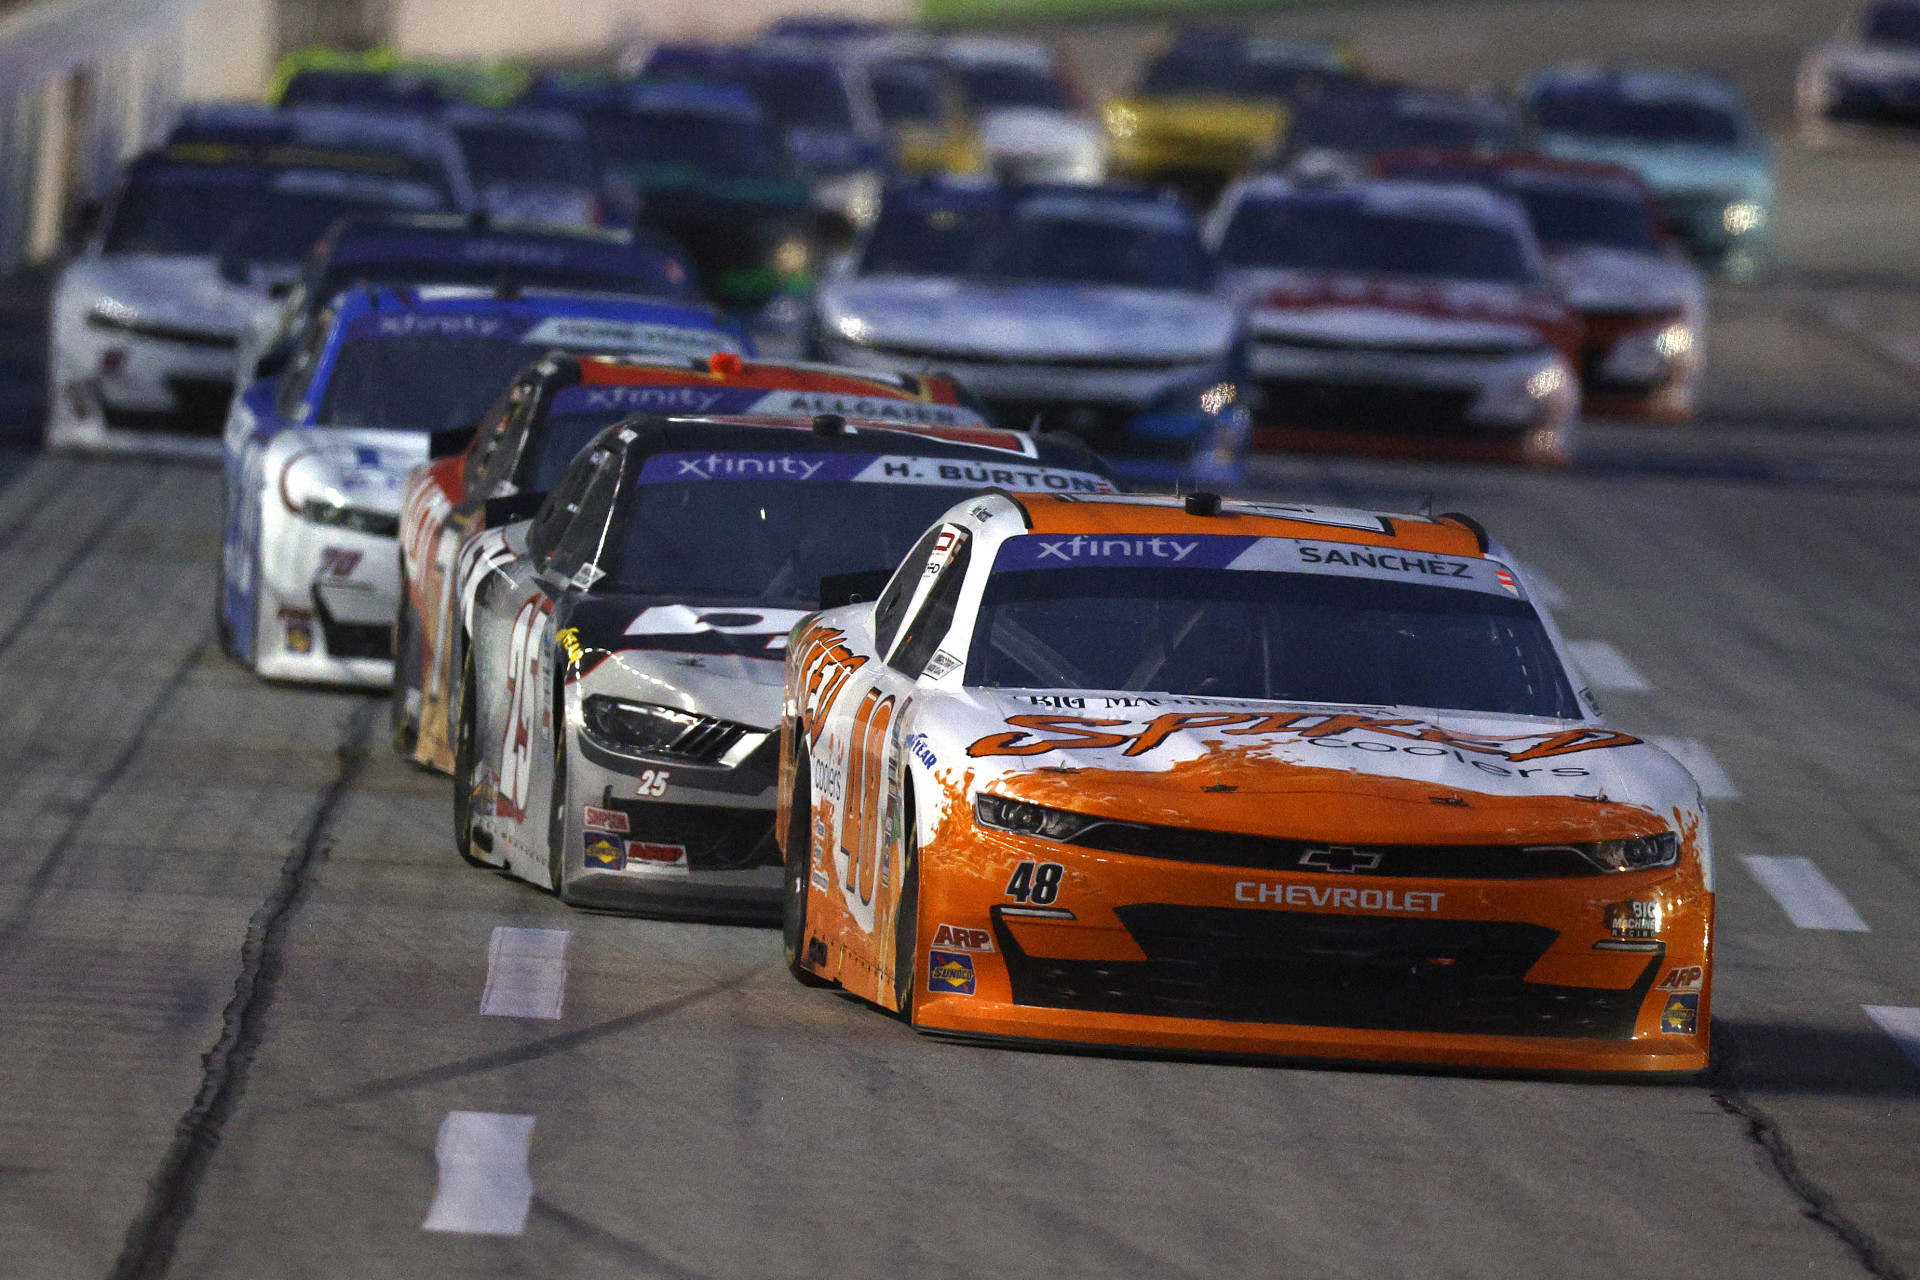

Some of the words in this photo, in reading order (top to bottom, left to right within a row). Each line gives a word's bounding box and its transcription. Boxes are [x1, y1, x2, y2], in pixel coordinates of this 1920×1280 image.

[587, 385, 724, 408] xfinity
[678, 453, 824, 479] xfinity
[885, 461, 923, 478] H.
[940, 463, 1096, 492] BURTON
[1036, 536, 1199, 562] xfinity
[1298, 546, 1474, 580] SANCHEZ
[1308, 737, 1590, 778] coolers
[637, 769, 671, 798] 25
[1005, 860, 1065, 905] 48
[1235, 881, 1445, 912] CHEVROLET
[933, 924, 990, 949] ARP
[1611, 929, 1656, 938] RACING
[1612, 917, 1656, 930] MACHINE
[932, 965, 974, 981] SUNOCO
